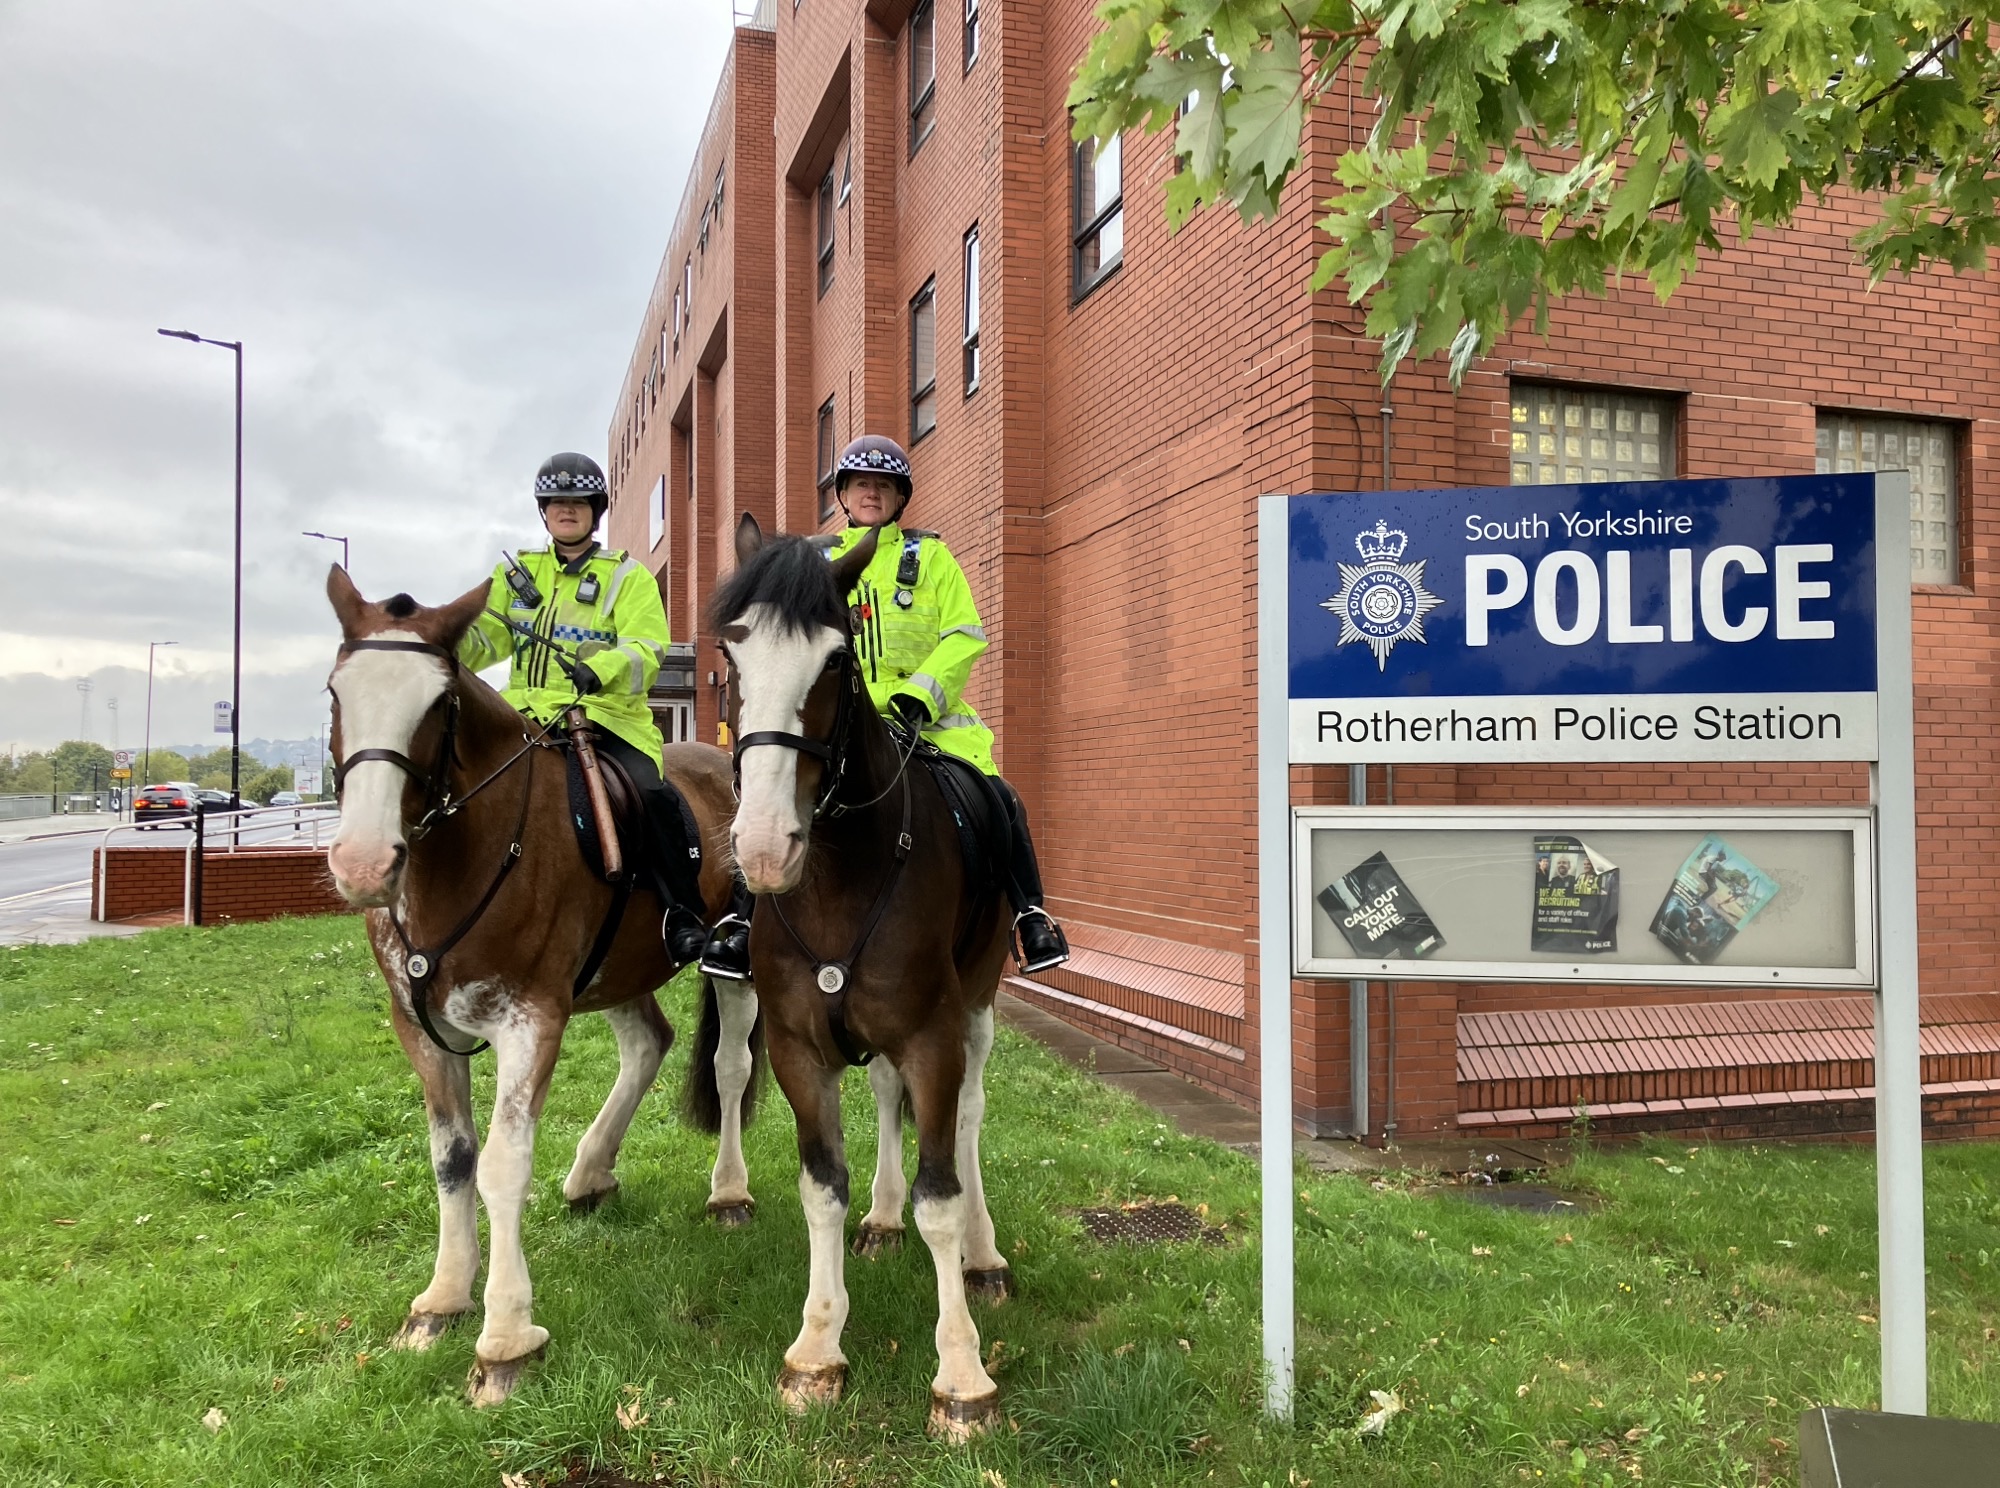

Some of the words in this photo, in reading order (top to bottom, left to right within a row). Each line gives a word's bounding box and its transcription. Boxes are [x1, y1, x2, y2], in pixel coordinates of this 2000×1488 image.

[1465, 513, 1549, 541] South
[1559, 509, 1693, 538] Yorkshire
[1350, 580, 1369, 617] SOUTH
[1369, 573, 1414, 616] YORKSHIRE
[1465, 543, 1835, 647] POLICE
[1362, 621, 1403, 635] POLICE
[1317, 709, 1537, 743] Rotherham
[1554, 707, 1678, 741] Police
[1693, 705, 1842, 740] Station
[1343, 904, 1377, 928] CALL
[1373, 885, 1399, 908] OUT
[1538, 897, 1581, 907] RECRUITING
[1539, 888, 1550, 897] WE
[1551, 888, 1566, 898] ARE
[1360, 903, 1398, 930] YOUR
[1550, 909, 1567, 917] variety
[1366, 913, 1406, 942] MATE.
[1592, 940, 1612, 949] POLICE
